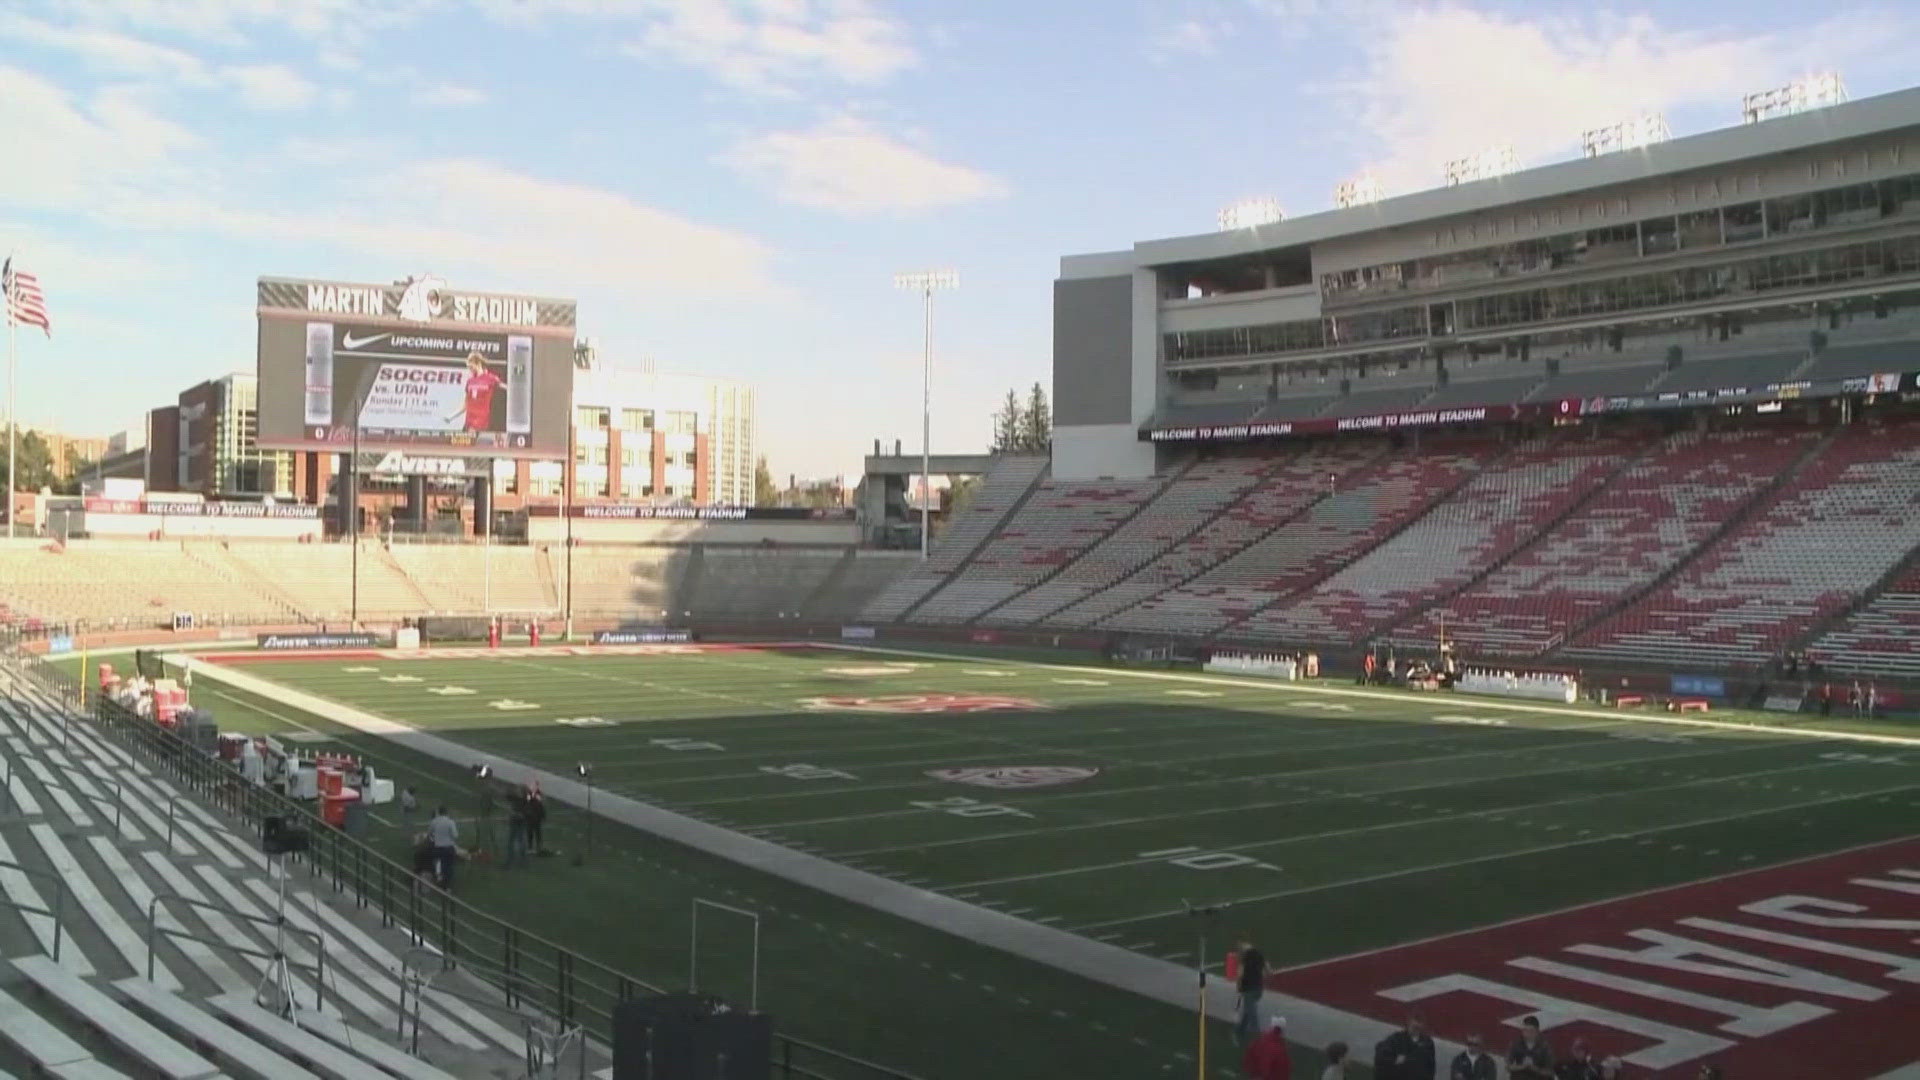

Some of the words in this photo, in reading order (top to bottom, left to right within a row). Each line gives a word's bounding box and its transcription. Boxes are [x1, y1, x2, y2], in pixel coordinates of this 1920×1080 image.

[307, 284, 383, 315] MARTIN
[454, 297, 537, 326] STADIUM
[391, 336, 453, 350] UPCOMING
[456, 339, 500, 353] EVENTS
[380, 367, 463, 384] SOCCER
[395, 384, 428, 396] UTAH
[1561, 400, 1569, 413] 0
[1337, 415, 1384, 430] WELCOME
[1385, 414, 1398, 426] TO
[1400, 412, 1437, 425] MARTIN
[1439, 408, 1486, 422] STADIUM
[315, 426, 324, 440] 0
[1151, 427, 1197, 441] WELCOME
[1199, 427, 1211, 439] TO
[1213, 425, 1248, 439] MARTIN
[1250, 423, 1292, 436] STADIUM
[517, 435, 526, 448] 0
[147, 503, 200, 515] WELCOME
[206, 504, 219, 516] TO
[222, 504, 264, 517] MARTIN
[266, 506, 317, 518] STADIUM
[584, 507, 636, 519] WELCOME
[640, 508, 654, 518] TO
[656, 508, 697, 519] MARTIN
[698, 509, 746, 520] STADIUM
